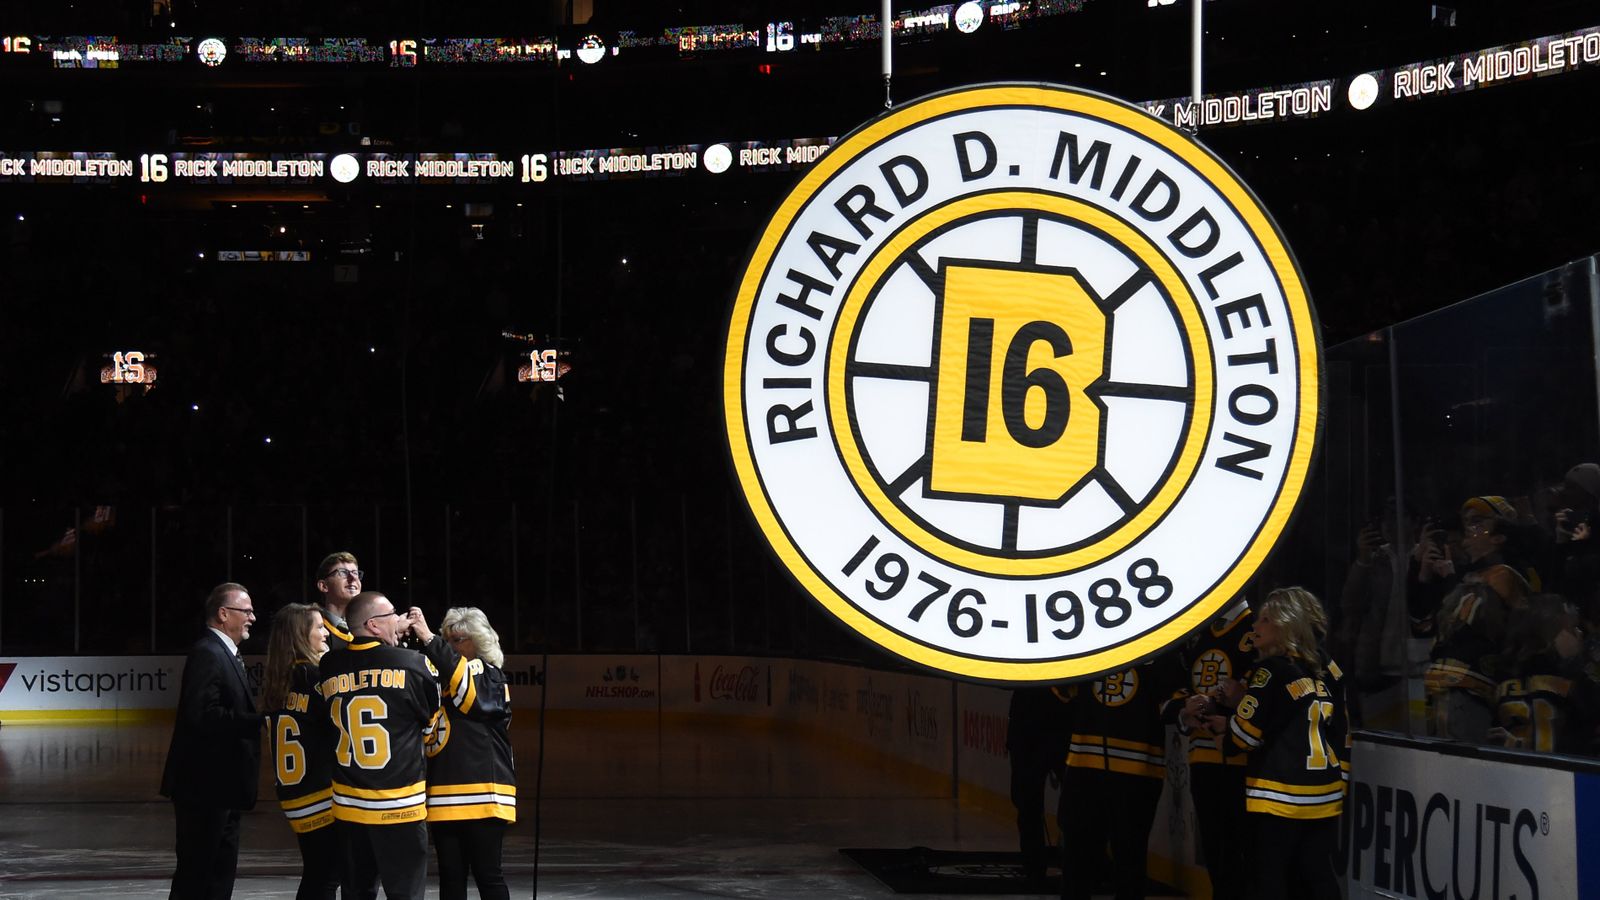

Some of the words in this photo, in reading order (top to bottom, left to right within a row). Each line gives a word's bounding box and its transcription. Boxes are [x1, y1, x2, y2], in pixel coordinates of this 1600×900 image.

[1394, 62, 1455, 99] RICK
[1464, 32, 1600, 86] MIDDLETO
[1174, 86, 1331, 127] MIDDLETON
[0, 159, 25, 176] CK
[30, 159, 133, 176] MIDDLETON
[140, 153, 168, 182] 16
[175, 160, 217, 177] RICK
[222, 160, 324, 177] MIDDLETON
[367, 160, 409, 177] RICK
[414, 160, 514, 177] MIDDLETON
[521, 153, 548, 183] 16
[554, 157, 595, 175] RICK
[599, 152, 697, 173] MIDDLETON
[739, 148, 782, 166] RICK
[763, 154, 929, 445] RICHARD
[952, 130, 1020, 182] D.
[1049, 130, 1279, 481] MIDDLETON
[961, 317, 1073, 448] 16
[841, 534, 1174, 643] 1976-1988
[21, 668, 168, 697] vistaprint
[330, 695, 391, 769] 16
[1329, 781, 1540, 900] UPERCUTS
